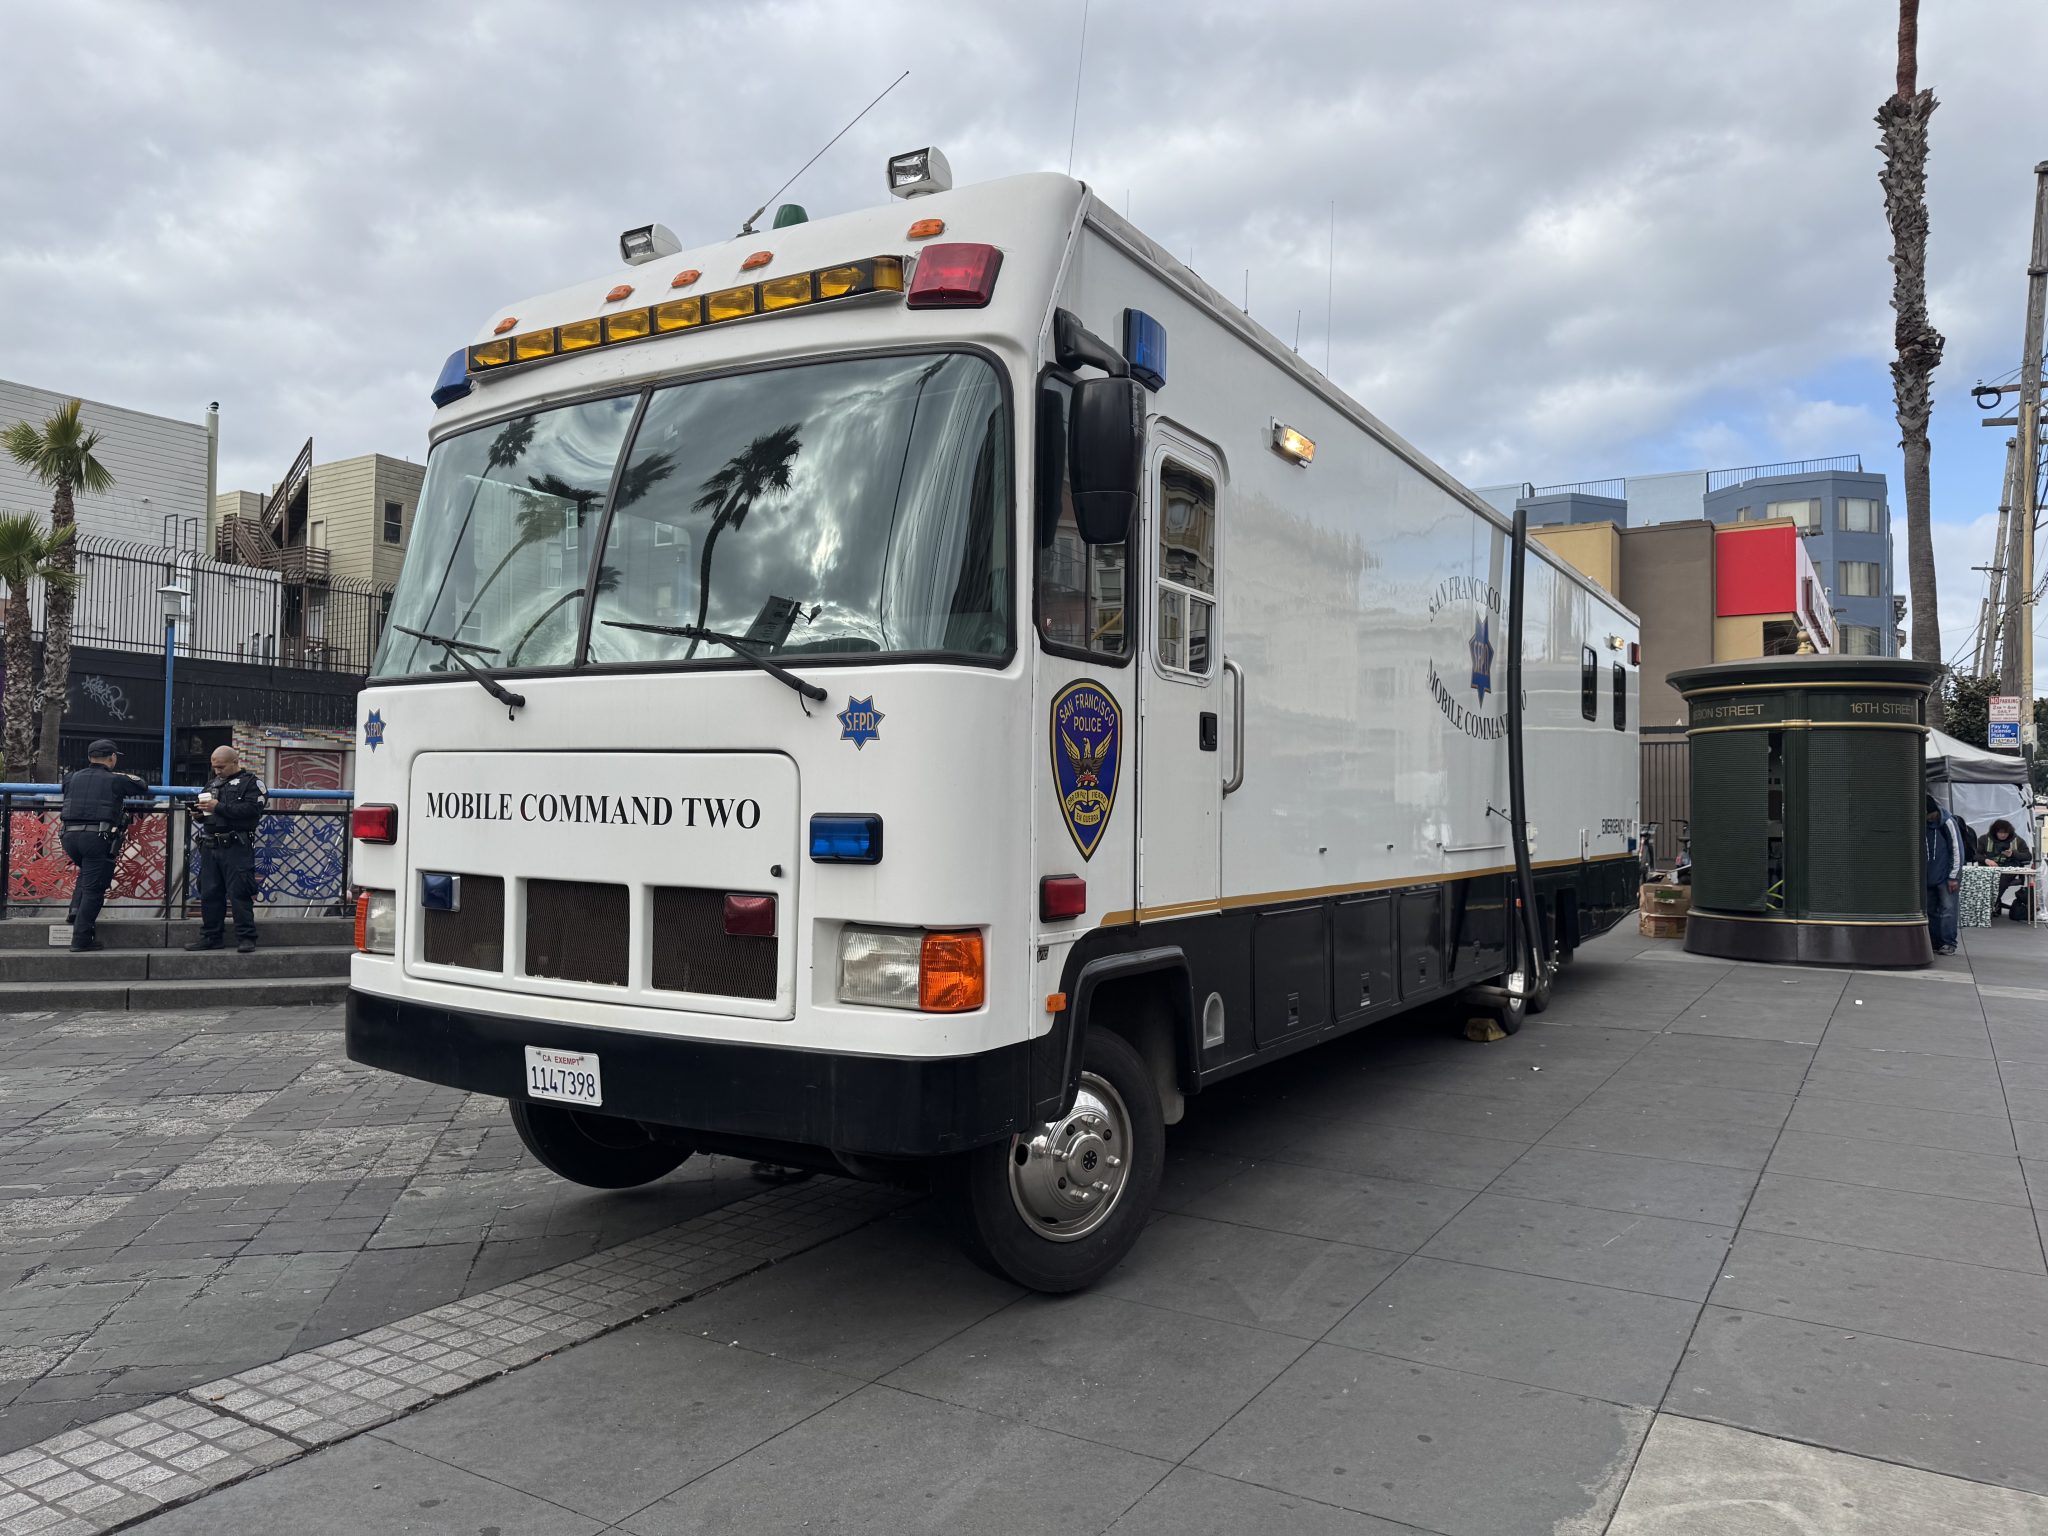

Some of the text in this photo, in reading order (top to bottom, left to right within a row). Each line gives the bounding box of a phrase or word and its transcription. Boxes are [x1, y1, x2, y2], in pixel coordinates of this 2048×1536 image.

[1449, 575, 1501, 615] FRANCISCO
[1060, 693, 1115, 727] SAN FRANCISCO
[1427, 656, 1463, 730] MOBILE
[1465, 711, 1509, 740] COMMAN
[1715, 704, 1765, 718] STREET
[1850, 702, 1879, 714] 16TH
[1073, 716, 1102, 732] POLICE
[426, 792, 761, 830] MOBILE COMMAND TWO
[542, 1054, 580, 1066] CA EXEMPT
[532, 1065, 596, 1098] 1147398
